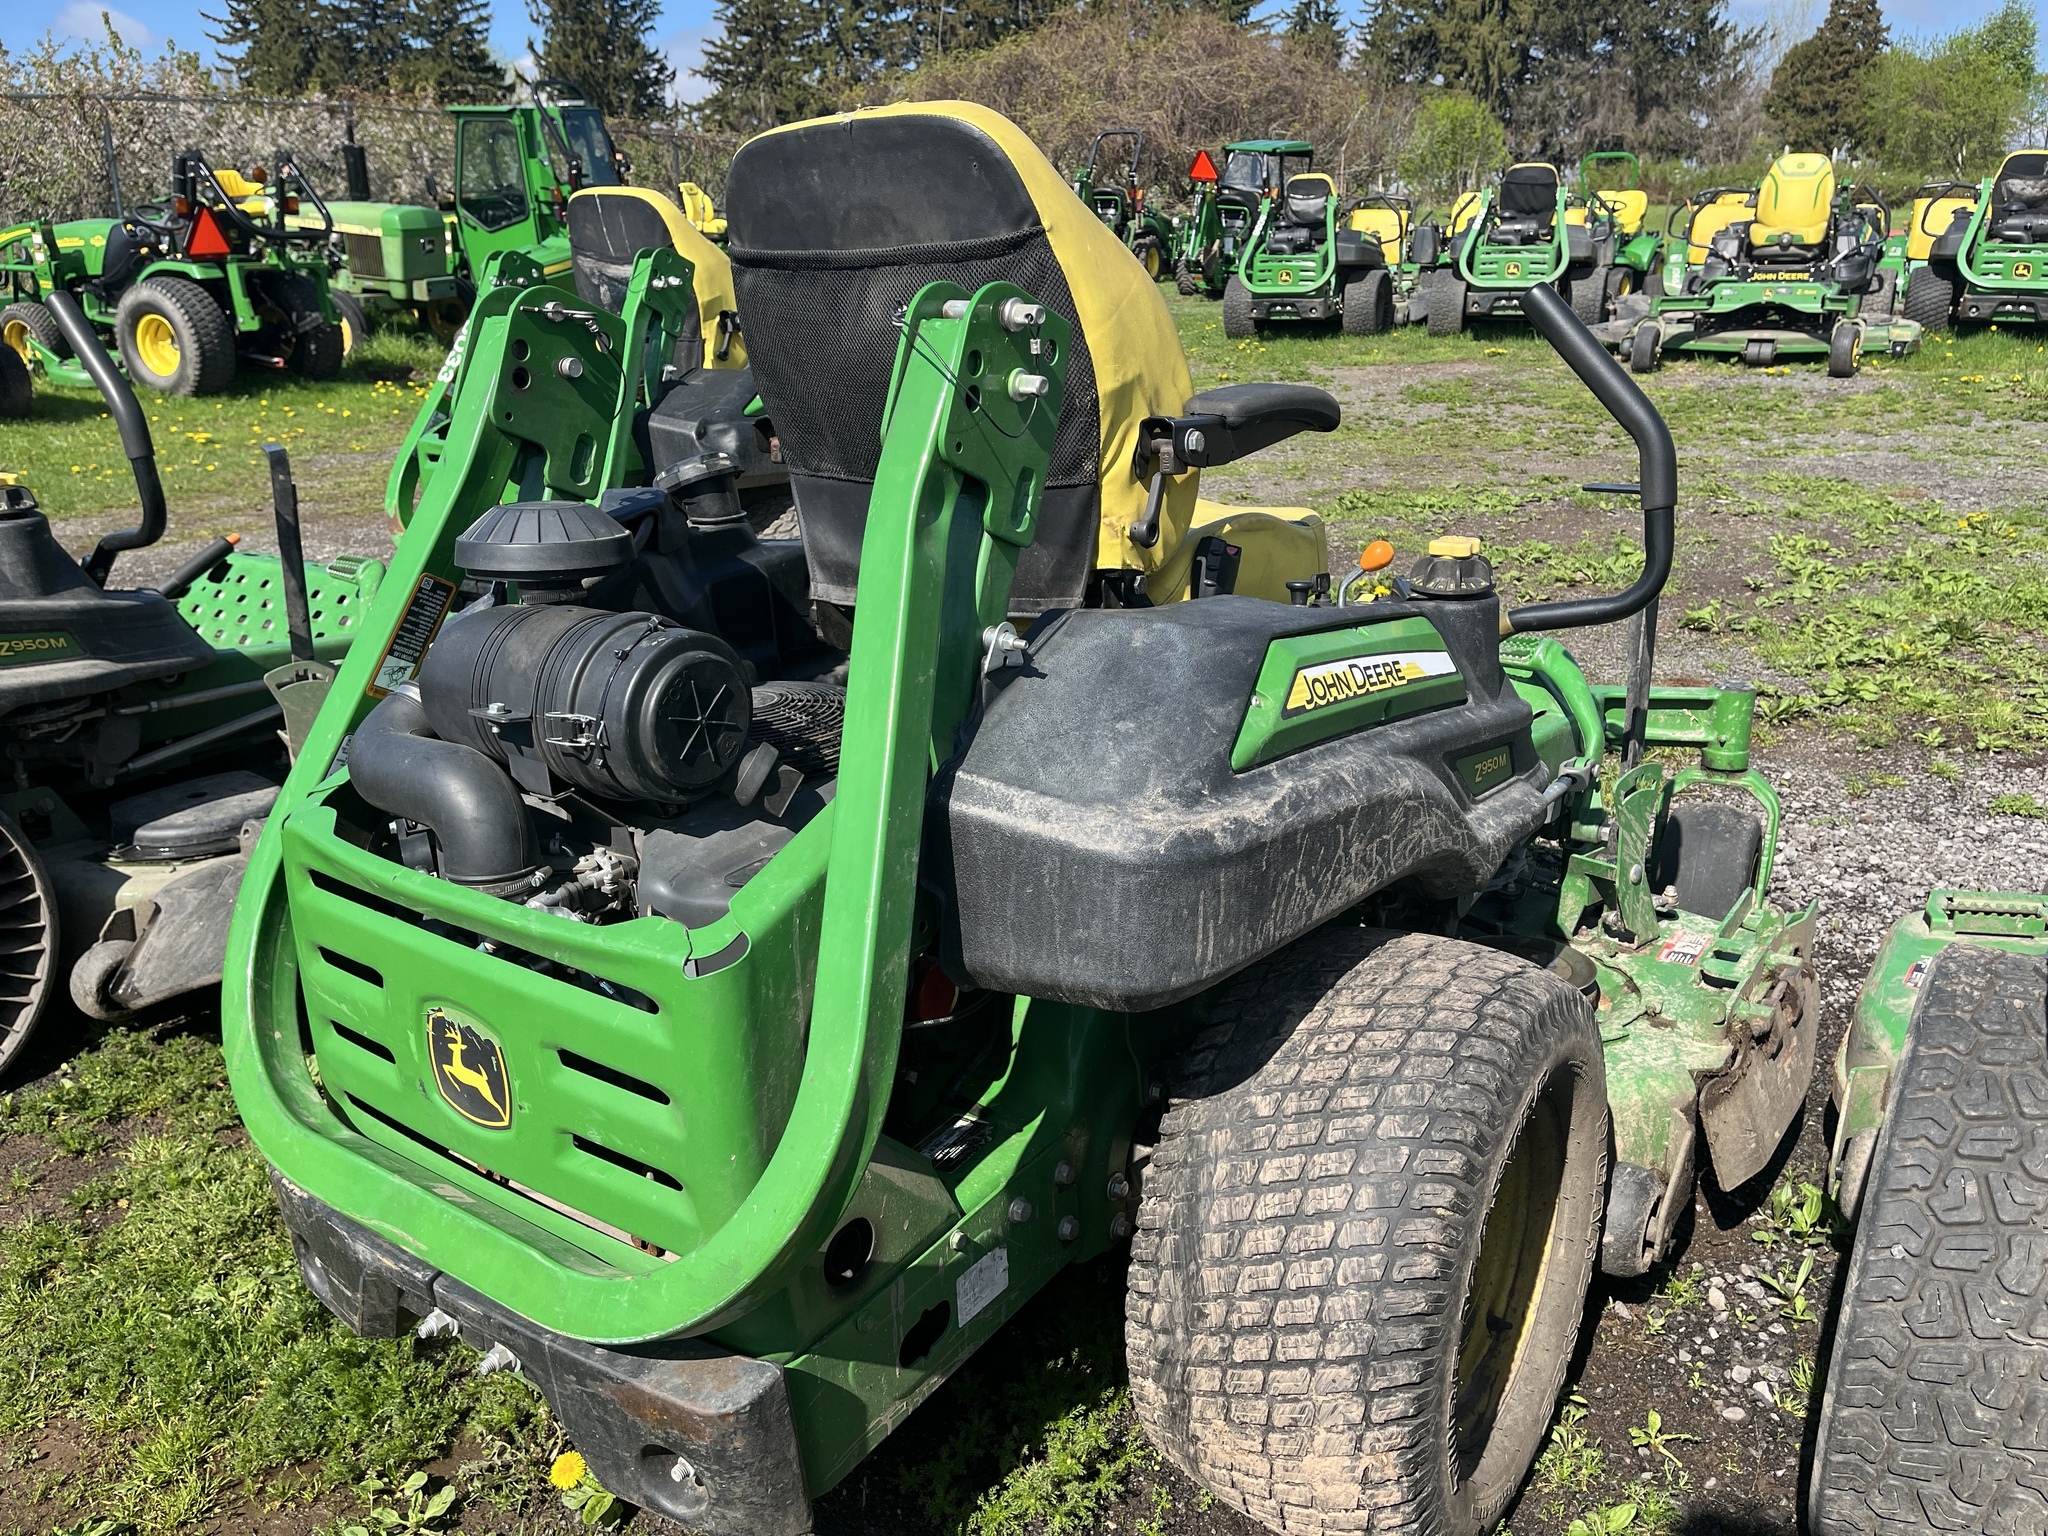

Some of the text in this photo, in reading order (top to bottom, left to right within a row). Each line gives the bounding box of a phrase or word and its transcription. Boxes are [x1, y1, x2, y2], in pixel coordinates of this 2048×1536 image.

[1750, 271, 1810, 281] JOHN DEERE
[0, 637, 67, 656] Z950M
[1304, 660, 1406, 705] JOHN DEERE
[1474, 753, 1507, 783] Z950M
